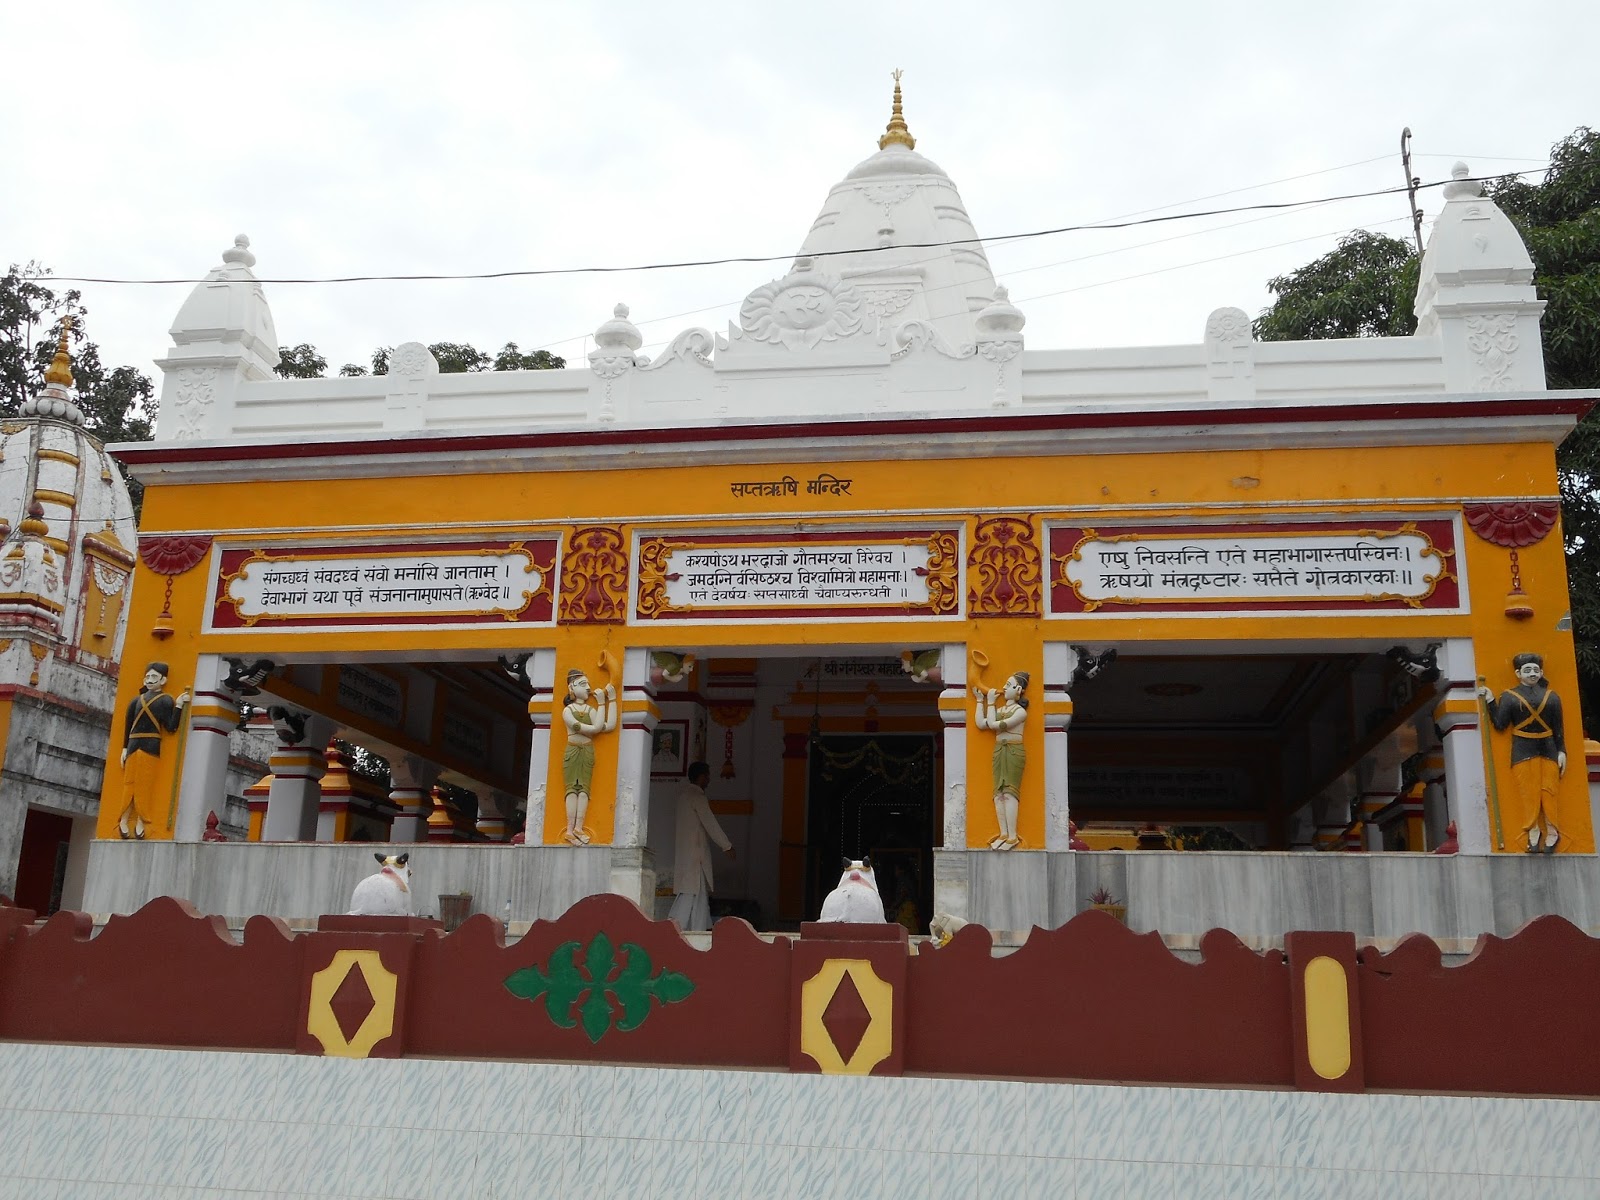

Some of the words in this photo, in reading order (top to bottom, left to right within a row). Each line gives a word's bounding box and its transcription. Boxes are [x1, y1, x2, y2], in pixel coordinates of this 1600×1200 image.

[731, 475, 799, 498] सप्तऋषि
[807, 473, 853, 496] मन्दिर
[1098, 552, 1129, 569] एषु
[1134, 546, 1210, 566] निवसन्ति
[1215, 545, 1246, 567] एते
[314, 566, 360, 584] संवदध्वं
[363, 565, 390, 582] संवो
[394, 562, 440, 581] मनांसि
[443, 565, 498, 582] जानताम्
[797, 567, 856, 584] विश्वामित्रो
[1099, 568, 1154, 589] ऋषयो
[260, 588, 308, 607] देवाभागं
[313, 590, 339, 604] यथा
[689, 587, 708, 602] एते
[877, 659, 911, 677] महादे
